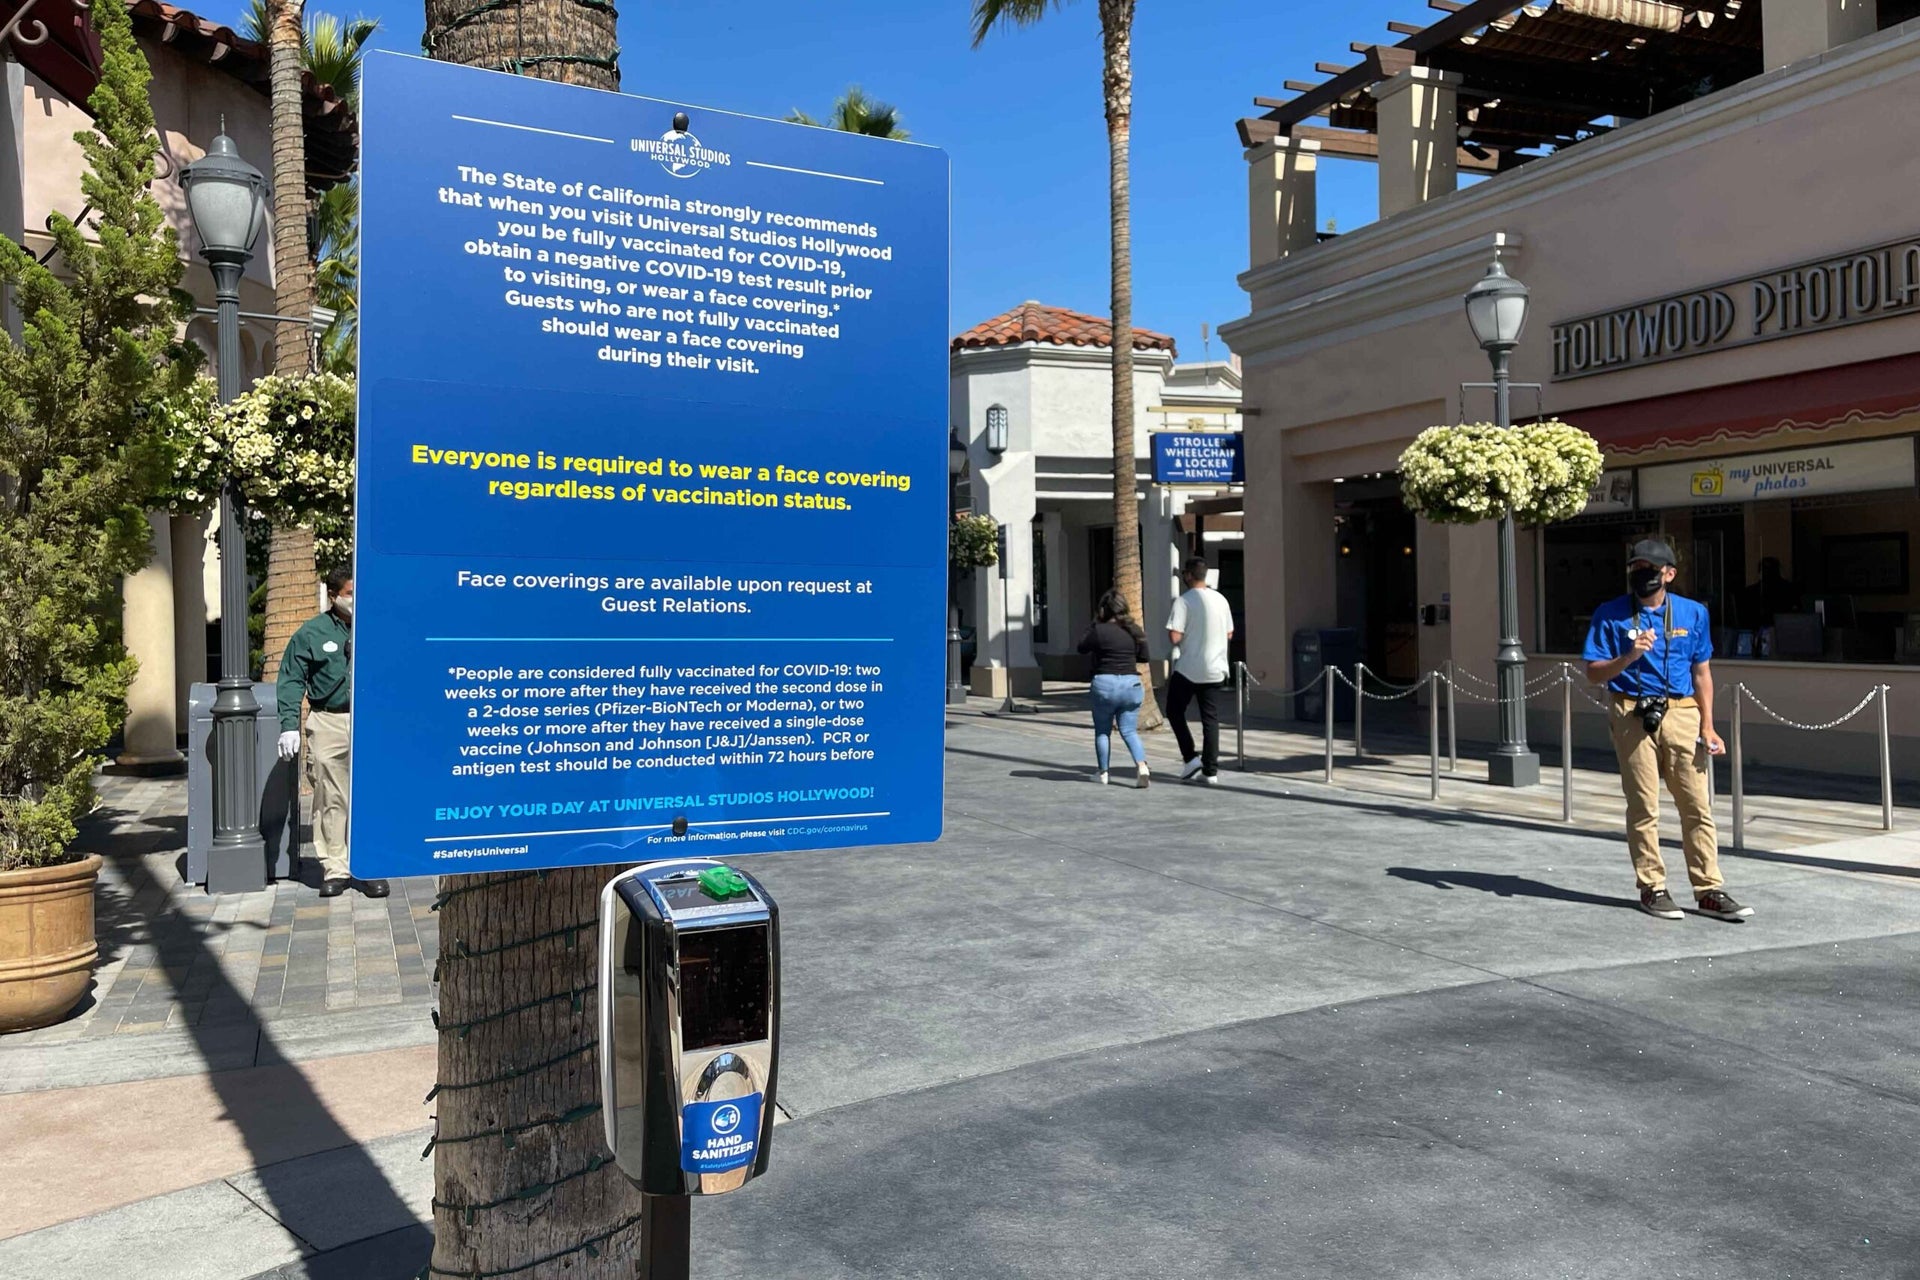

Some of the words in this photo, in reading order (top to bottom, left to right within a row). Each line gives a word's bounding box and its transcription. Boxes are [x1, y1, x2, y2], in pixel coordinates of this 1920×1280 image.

[630, 138, 686, 157] UNIVERSAL
[689, 146, 731, 167] STUDIOS
[651, 153, 710, 169] HOLLYWOOD
[457, 165, 497, 186] The
[502, 172, 557, 194] State
[561, 181, 583, 197] of
[587, 184, 681, 211] California
[685, 199, 762, 225] strongly
[766, 211, 877, 238] recommends
[438, 186, 483, 208] that
[487, 195, 543, 216] when
[548, 204, 586, 221] you
[591, 208, 633, 227] visit
[638, 213, 725, 239] Universal
[729, 225, 797, 248] Studios
[801, 235, 892, 261] Hollywood
[497, 220, 536, 238] you
[541, 223, 567, 241] be
[571, 227, 616, 250] fully
[620, 236, 723, 261] vaccinated
[727, 246, 755, 264] for
[758, 251, 846, 278] COVID-19,
[463, 238, 532, 260] obtain
[536, 249, 549, 262] a
[554, 251, 640, 273] negative
[645, 259, 733, 284] COVID-19
[737, 270, 773, 289] test
[776, 277, 827, 295] result
[830, 283, 873, 300] prior
[503, 266, 526, 283] to
[530, 269, 611, 295] visiting,
[616, 281, 638, 295] or
[641, 284, 689, 300] wear
[692, 289, 704, 303] a
[708, 288, 748, 307] face
[504, 289, 575, 311] Guests
[579, 298, 621, 316] who
[625, 305, 657, 320] are
[661, 308, 694, 324] not
[698, 309, 739, 331] fully
[743, 317, 839, 339] vaccinated
[541, 316, 609, 337] should
[613, 326, 662, 342] wear
[665, 331, 677, 344] a
[681, 329, 722, 348] face
[726, 337, 804, 359] covering
[1551, 291, 1735, 375] HOLLYWOOD
[597, 344, 662, 368] during
[665, 351, 711, 369] their
[715, 355, 759, 374] visit.
[412, 444, 531, 470] Everyone
[537, 450, 557, 470] is
[563, 455, 663, 476] required
[668, 459, 693, 477] to
[698, 464, 752, 480] wear
[757, 467, 770, 481] a
[775, 464, 820, 484] face
[824, 470, 911, 492] covering
[1174, 458, 1182, 468] &
[1185, 458, 1228, 468] LOCKER
[1185, 469, 1219, 478] RENTAL
[1729, 466, 1751, 483] my
[1752, 457, 1835, 476] UNIVERSAL
[488, 479, 615, 500] regardless
[621, 483, 646, 501] of
[651, 486, 778, 507] vaccination
[783, 492, 851, 510] status.
[1754, 474, 1807, 497] photos
[458, 570, 507, 587] Face
[512, 572, 609, 591] coverings
[614, 577, 645, 590] are
[650, 574, 732, 591] available
[737, 579, 782, 594] upon
[787, 579, 851, 595] request
[855, 579, 872, 594] at
[601, 596, 657, 612] Guest
[662, 597, 751, 613] Relations.
[517, 668, 544, 679] are
[548, 665, 635, 679] considered
[639, 664, 672, 680] fully
[676, 664, 755, 677] vaccinated
[758, 664, 780, 677] for
[783, 663, 852, 676] COVID-19:
[855, 664, 881, 676] two
[444, 685, 497, 699] weeks
[501, 687, 520, 698] or
[524, 687, 566, 698] more
[570, 683, 608, 697] after
[611, 683, 646, 699] they
[650, 683, 685, 696] have
[689, 681, 751, 695] received
[754, 681, 778, 694] the
[781, 680, 831, 694] second
[834, 680, 867, 693] dose
[870, 680, 883, 692] in
[467, 707, 478, 718] a
[482, 703, 539, 718] 2-dose
[543, 702, 590, 716] series
[594, 699, 722, 717] (Pfizer-BioNTech
[725, 702, 742, 712] or
[745, 698, 817, 712] Moderna),
[820, 700, 836, 710] or
[838, 698, 864, 710] two
[466, 722, 519, 737] weeks
[522, 724, 541, 736] or
[545, 723, 587, 735] more
[590, 720, 629, 733] after
[632, 719, 666, 734] they
[670, 718, 705, 731] have
[708, 715, 770, 730] received
[773, 718, 782, 728] a
[785, 714, 864, 730] single-dose
[459, 741, 522, 756] vaccine
[527, 739, 601, 756] (Johnson
[604, 737, 634, 751] and
[638, 736, 701, 750] Johnson
[705, 732, 815, 750] [J&J]/Janssen).
[822, 731, 851, 744] PCR
[854, 733, 870, 743] or
[451, 761, 515, 777] antigen
[519, 759, 551, 773] test
[555, 756, 608, 772] should
[612, 756, 632, 769] be
[635, 752, 715, 769] conducted
[719, 751, 763, 765] within
[767, 750, 785, 763] 72
[788, 749, 827, 762] hours
[830, 747, 874, 760] before
[434, 804, 494, 821] ENJOY
[497, 802, 547, 817] YOUR
[551, 800, 584, 815] DAY
[587, 799, 610, 813] AT
[613, 794, 705, 811] UNIVERSAL
[707, 791, 774, 806] STUDIOS
[777, 786, 874, 803] HOLLYWOOD!
[647, 836, 662, 844] For
[664, 834, 686, 843] more
[688, 831, 739, 841] information,
[740, 830, 767, 840] please
[768, 828, 785, 837] visit
[787, 823, 868, 835] CDC.gov/coronavirus
[433, 844, 529, 859] #SafetyIsUniversal
[692, 1141, 754, 1160] SANITIZER
[707, 1134, 742, 1149] HAND
